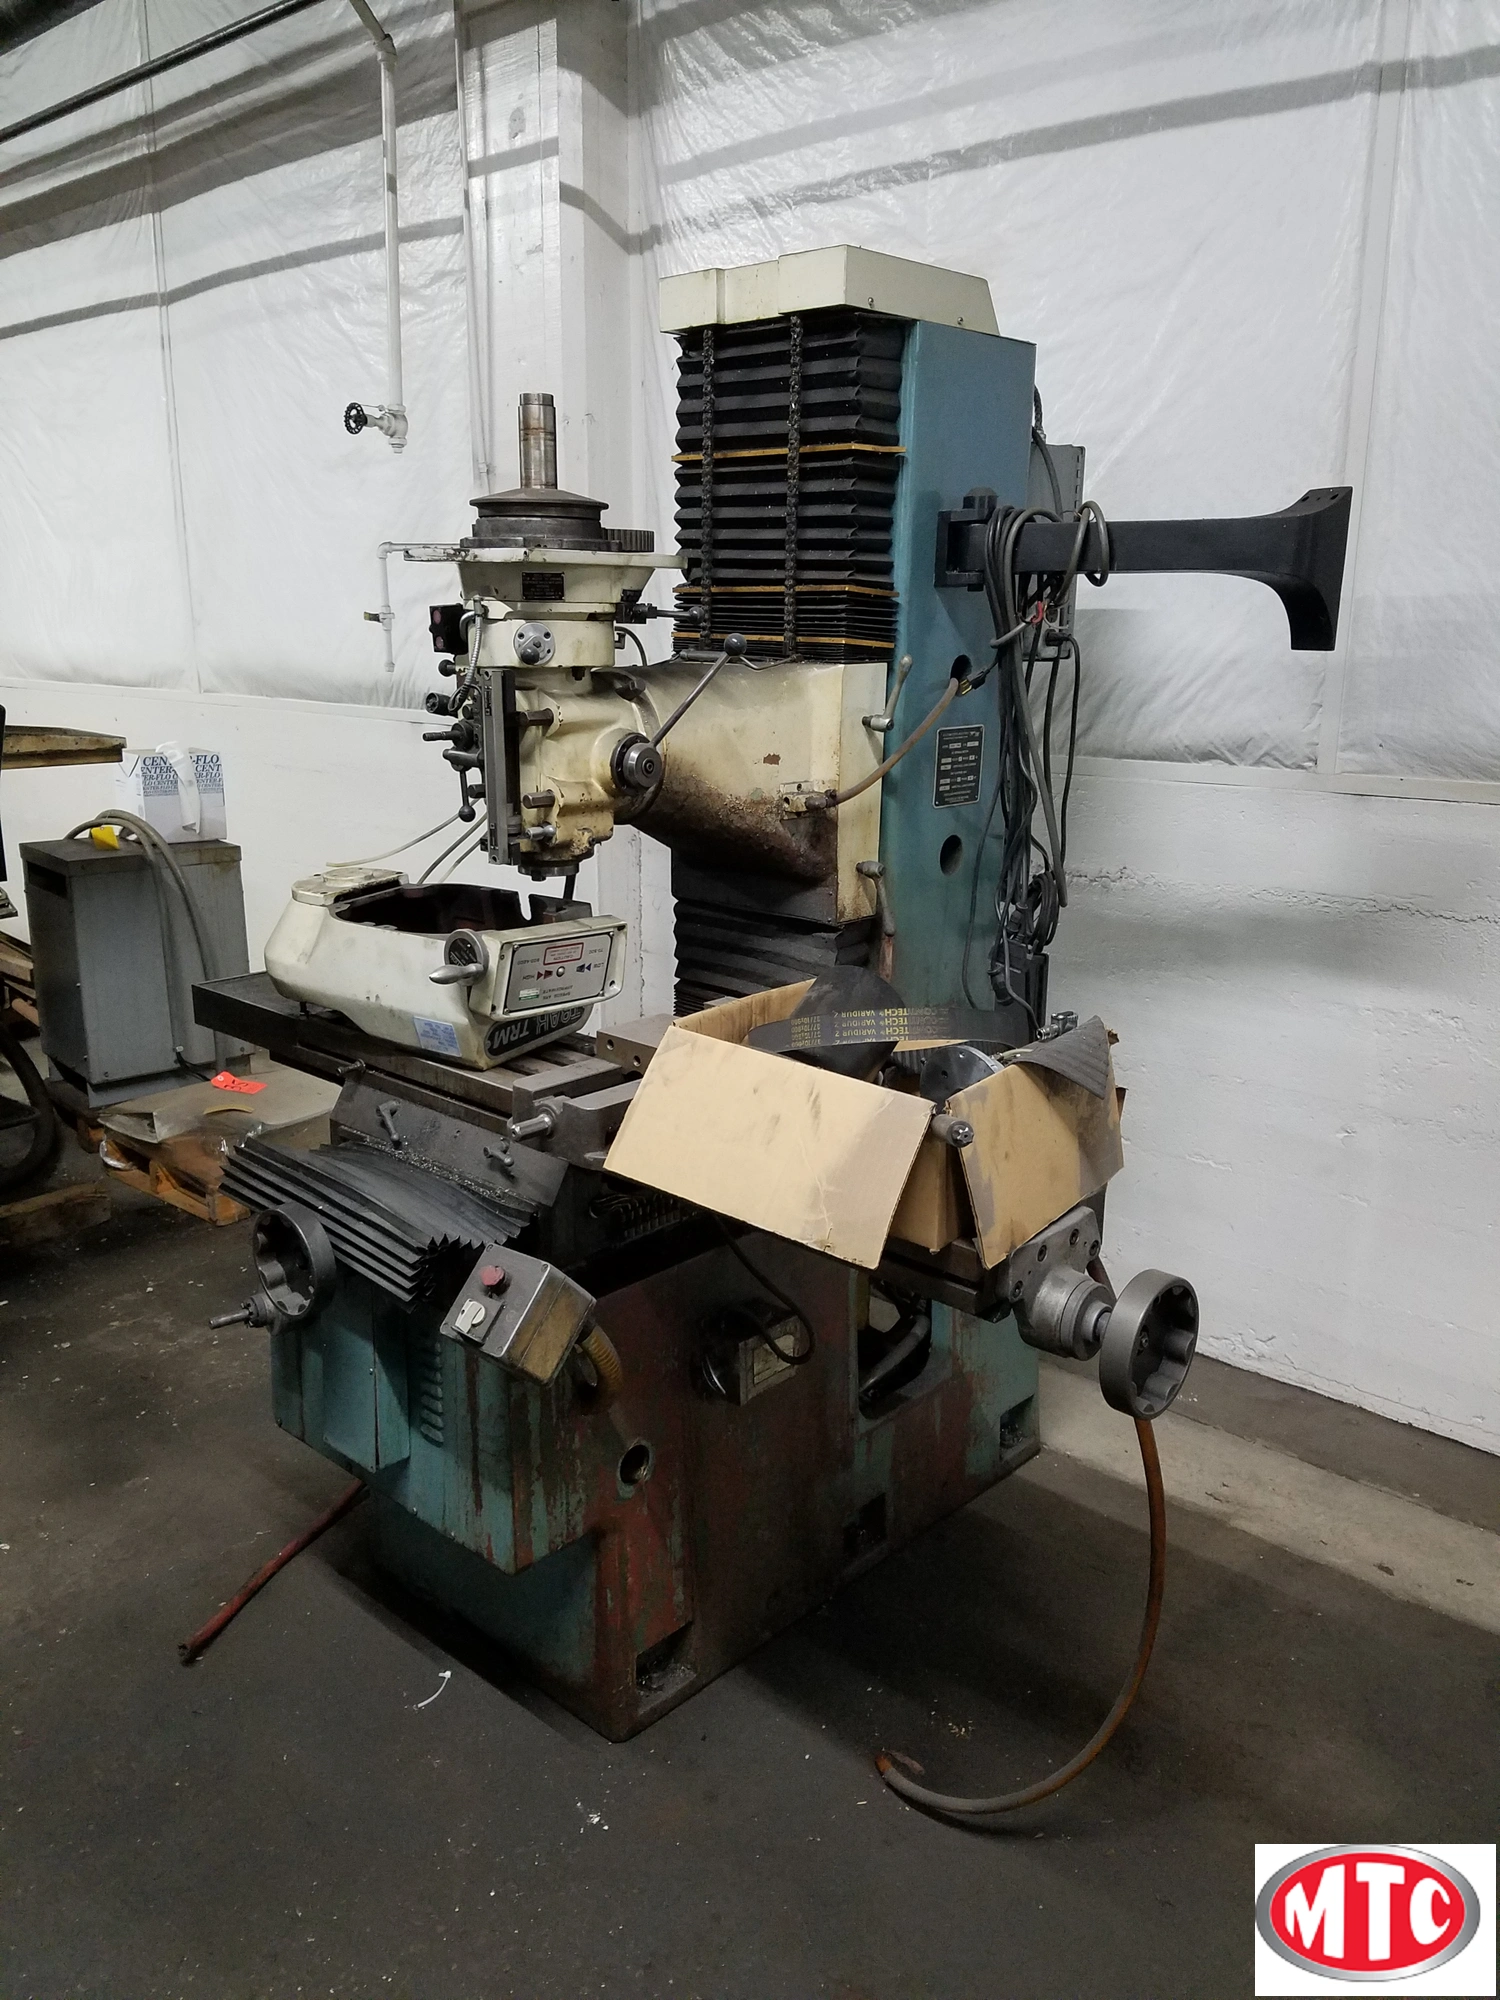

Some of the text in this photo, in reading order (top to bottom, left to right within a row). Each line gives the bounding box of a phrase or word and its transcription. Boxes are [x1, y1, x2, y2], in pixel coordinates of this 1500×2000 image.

[841, 1010, 876, 1018] VARIDUR
[493, 1006, 581, 1049] TRAK TRM
[842, 1019, 876, 1028] VARIDUR
[842, 1029, 877, 1037] VARIDUR
